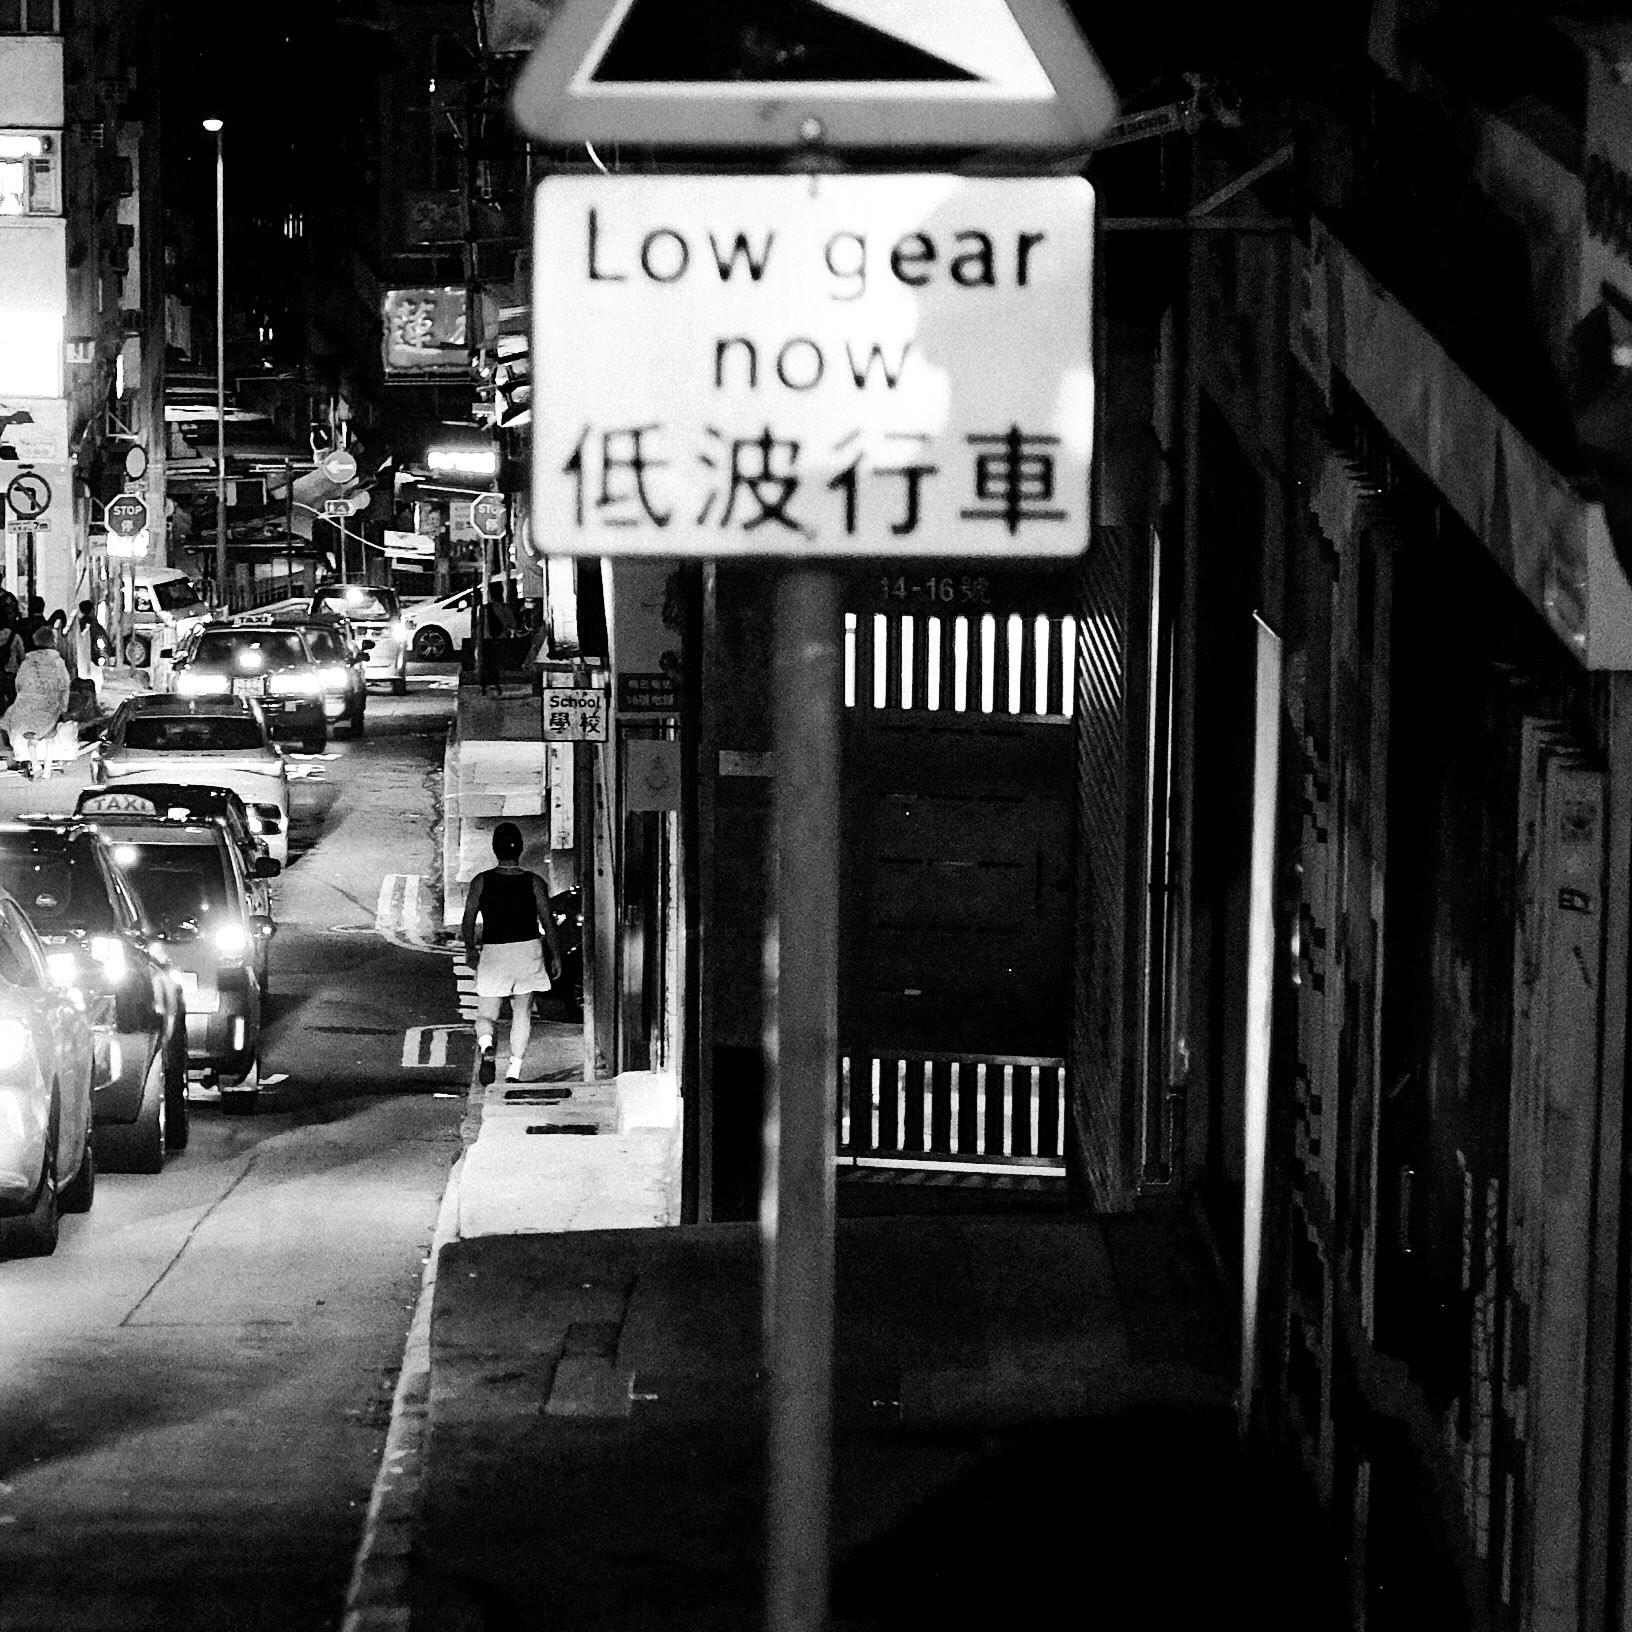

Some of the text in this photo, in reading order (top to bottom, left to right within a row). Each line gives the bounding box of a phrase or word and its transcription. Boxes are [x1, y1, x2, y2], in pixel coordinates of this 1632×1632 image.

[586, 206, 1044, 301] Low gear
[714, 333, 914, 391] now
[563, 425, 1068, 536] 低波行車
[113, 505, 143, 516] STOP
[549, 695, 600, 708] School
[549, 711, 601, 734] 學校
[94, 796, 146, 811] TAXI
